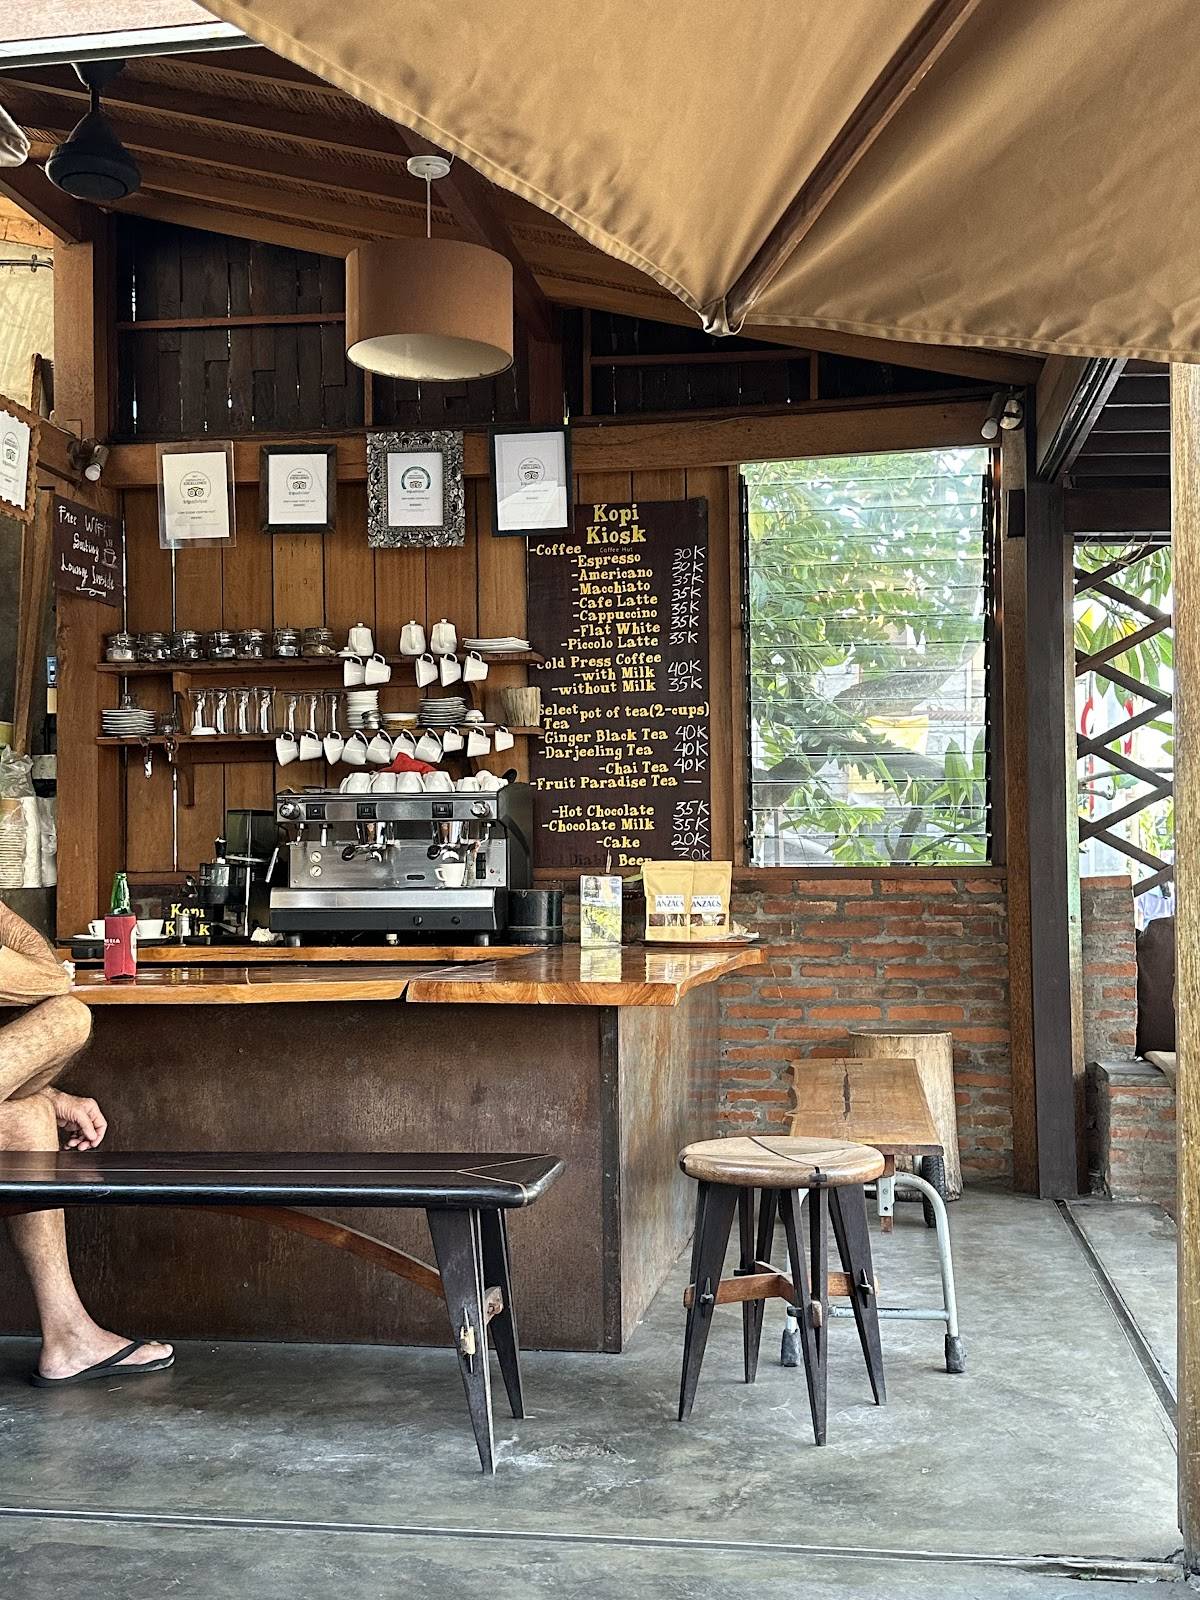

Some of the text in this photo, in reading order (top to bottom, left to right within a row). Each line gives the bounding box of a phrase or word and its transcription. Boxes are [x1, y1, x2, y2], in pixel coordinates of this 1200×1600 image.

[58, 505, 78, 525] Free
[593, 503, 640, 527] Kopi
[586, 525, 647, 545] Kiosk
[529, 544, 582, 556] -Coffee
[599, 546, 620, 554] Coffee
[570, 553, 641, 569] -Espresso
[571, 567, 654, 582] -Americano
[672, 573, 705, 587] 35K
[571, 580, 651, 596] -Macchiato
[671, 586, 702, 602] 35K
[572, 594, 659, 609] -Cafe Latte
[671, 600, 700, 616] 35K
[572, 608, 659, 625] -Cappuccino
[670, 614, 699, 630] 35K
[573, 622, 661, 638] -Flat White
[560, 636, 659, 651] -Piccolo Latte
[669, 631, 699, 646] 35K
[570, 655, 612, 668] Press
[615, 652, 662, 666] Coffee
[667, 659, 702, 677] 40K
[574, 665, 656, 682] -with Milk
[551, 677, 656, 696] -without Milk
[667, 676, 703, 692] 35K
[580, 707, 602, 723] pot
[606, 705, 620, 719] of
[625, 701, 710, 719] tea(2-cups)
[543, 717, 570, 730] Tea
[538, 727, 669, 747] -Ginger Black Tea
[674, 724, 709, 742] 40K
[538, 743, 654, 762] -Darjeeling Tea
[672, 740, 709, 758] 40K
[598, 760, 669, 776] -Chai Tea
[673, 757, 706, 774] 40K
[529, 774, 678, 791] -Fruit Paradise Tea
[551, 804, 655, 819] -Hot Chocolate
[672, 800, 710, 818] 35K
[541, 817, 655, 833] -Chocolate Milk
[672, 817, 710, 832] 35K
[596, 836, 640, 849] -Cake
[671, 832, 711, 848] 20K
